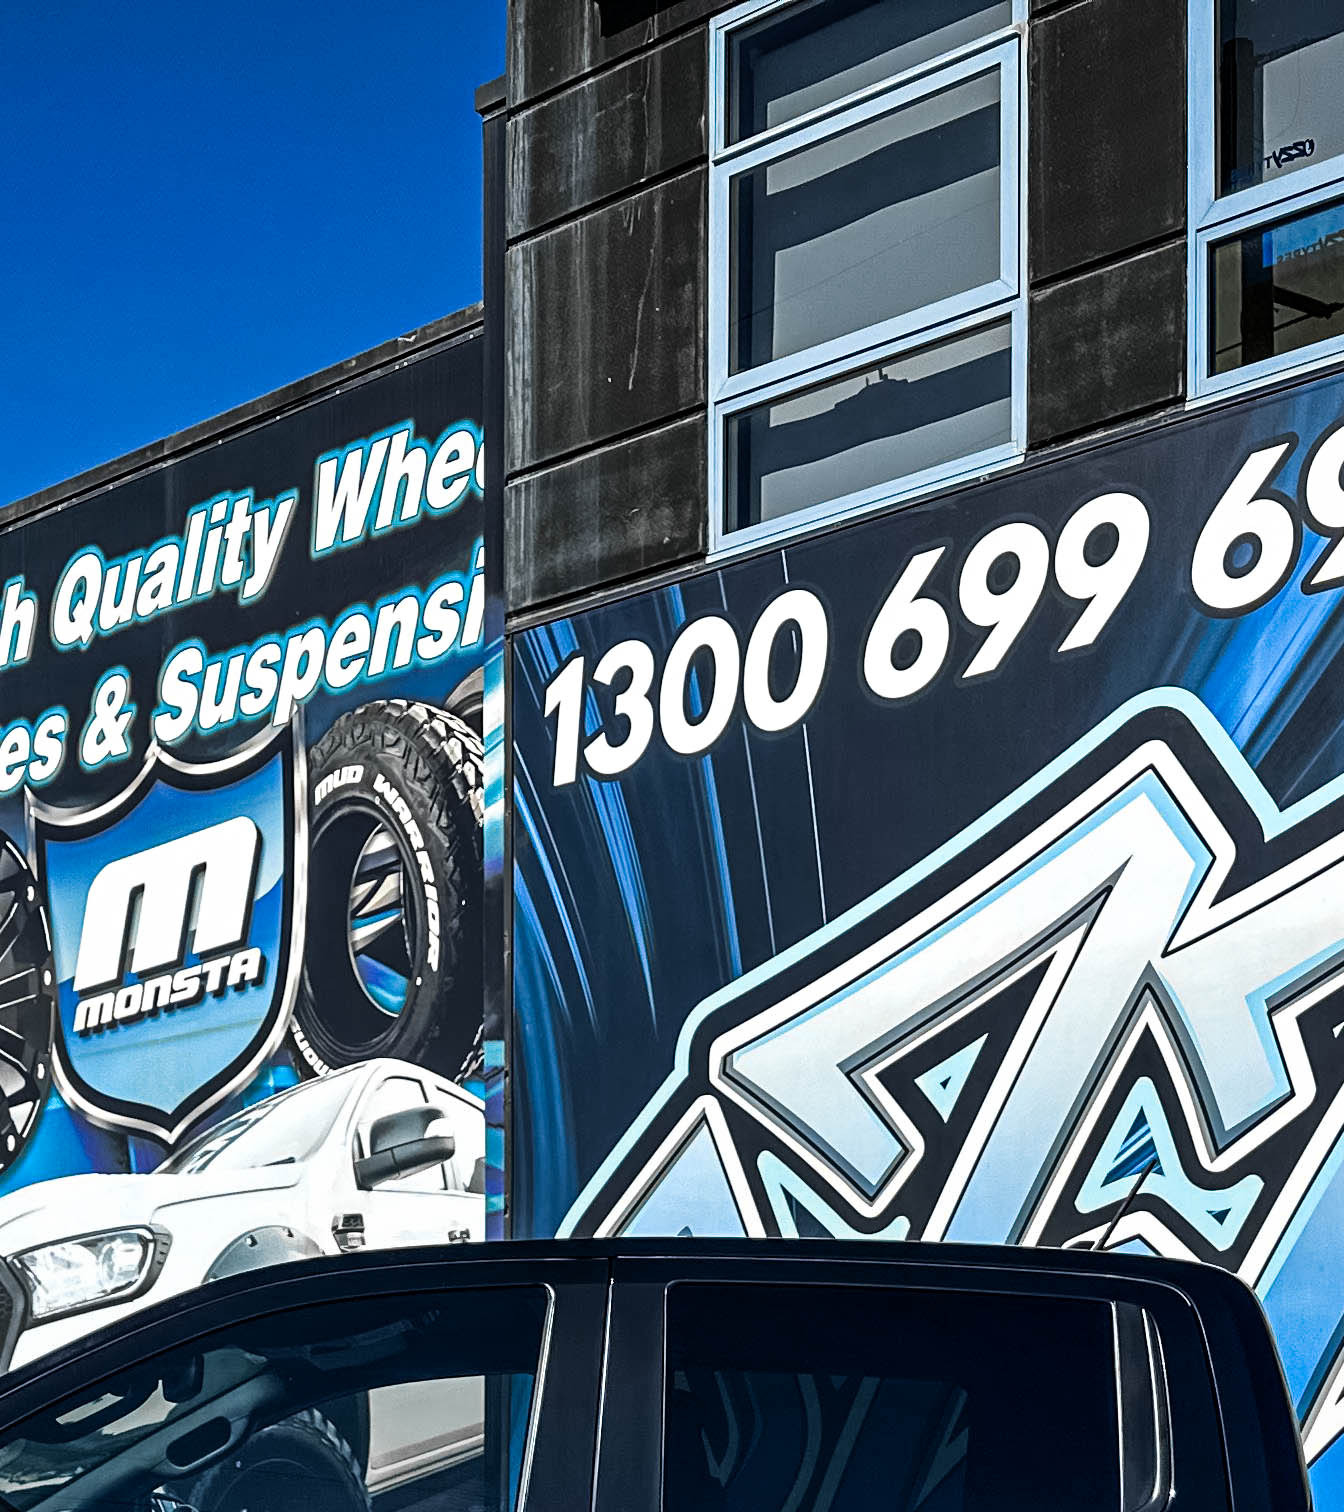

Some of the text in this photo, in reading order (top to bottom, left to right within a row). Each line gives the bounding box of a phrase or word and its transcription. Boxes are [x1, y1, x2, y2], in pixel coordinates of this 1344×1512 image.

[53, 497, 295, 646] Quality
[544, 589, 828, 787] 1300
[864, 492, 1150, 699] 699
[82, 674, 133, 766] &
[314, 764, 441, 973] MUD WARRIOR
[73, 947, 262, 1033] MONSTA
